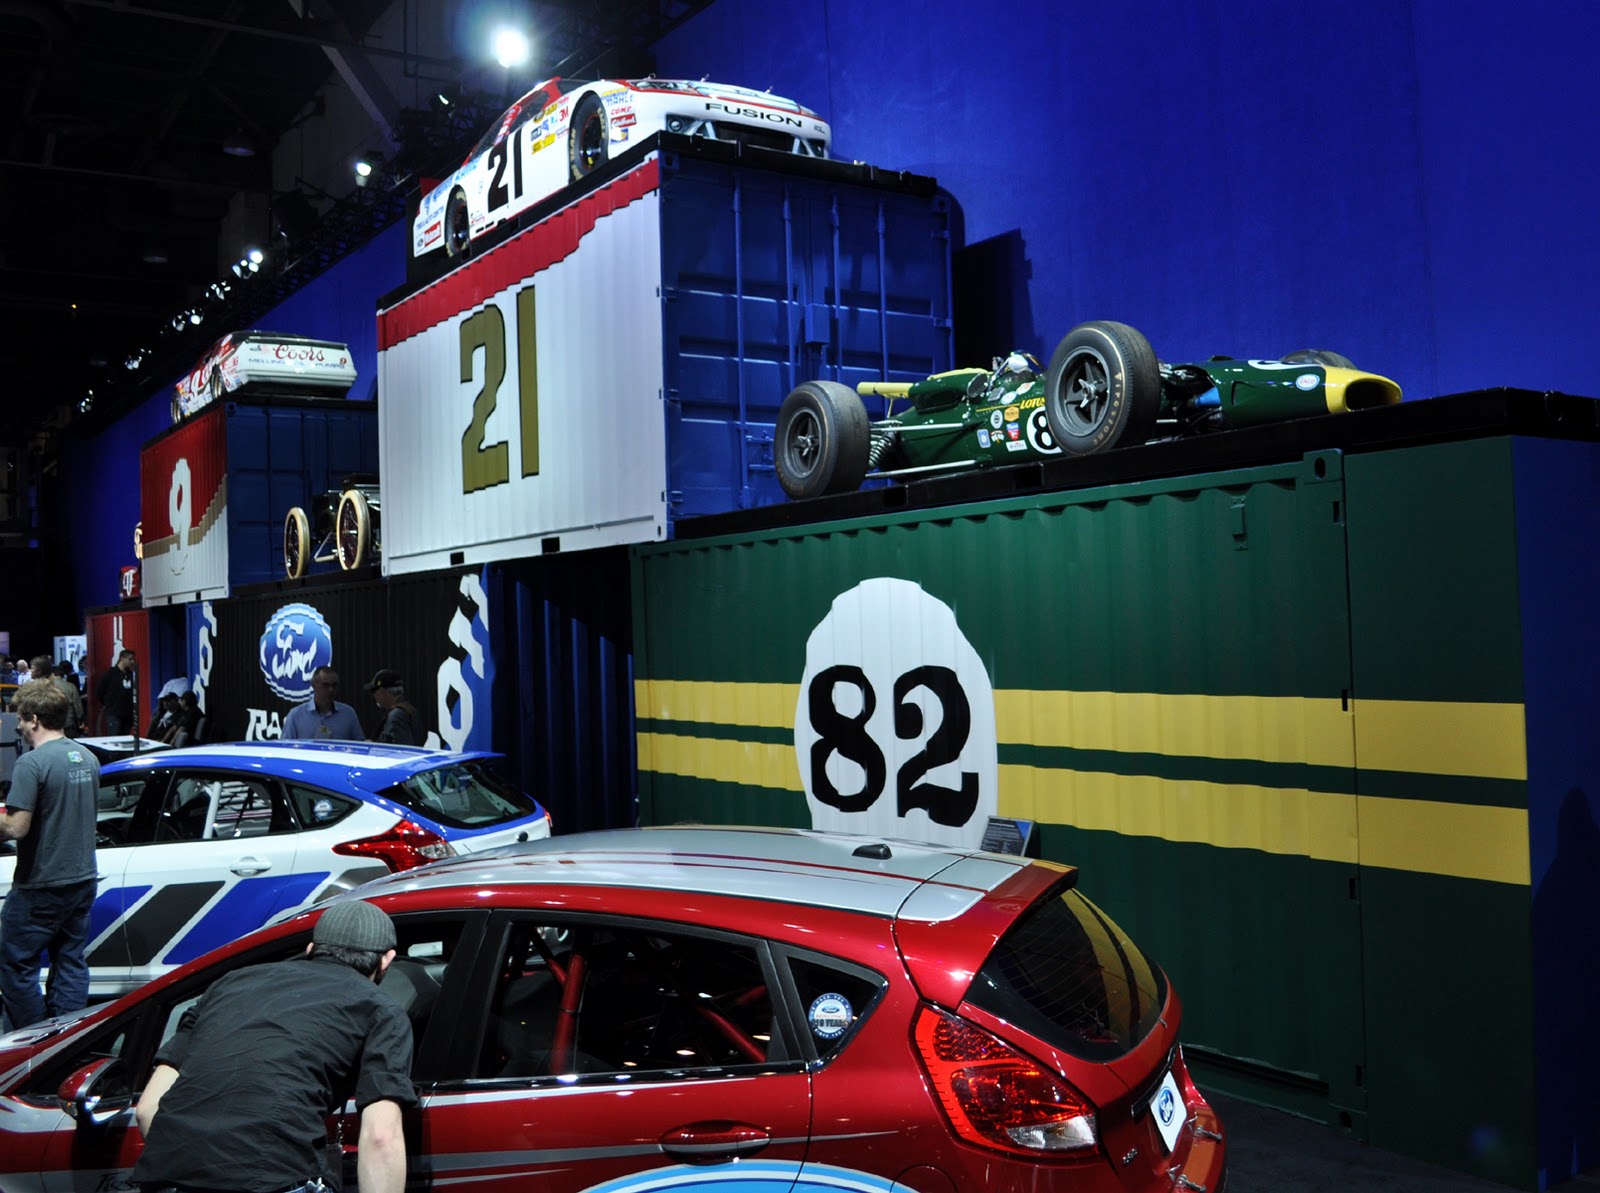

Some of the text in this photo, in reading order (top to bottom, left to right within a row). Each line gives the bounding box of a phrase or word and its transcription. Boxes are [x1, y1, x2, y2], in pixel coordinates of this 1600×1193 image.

[704, 102, 803, 128] FUSION
[487, 127, 524, 214] 21
[272, 344, 325, 362] Coors
[459, 284, 540, 495] 21
[808, 664, 980, 828] 82
[1160, 1093, 1173, 1122] Ford
